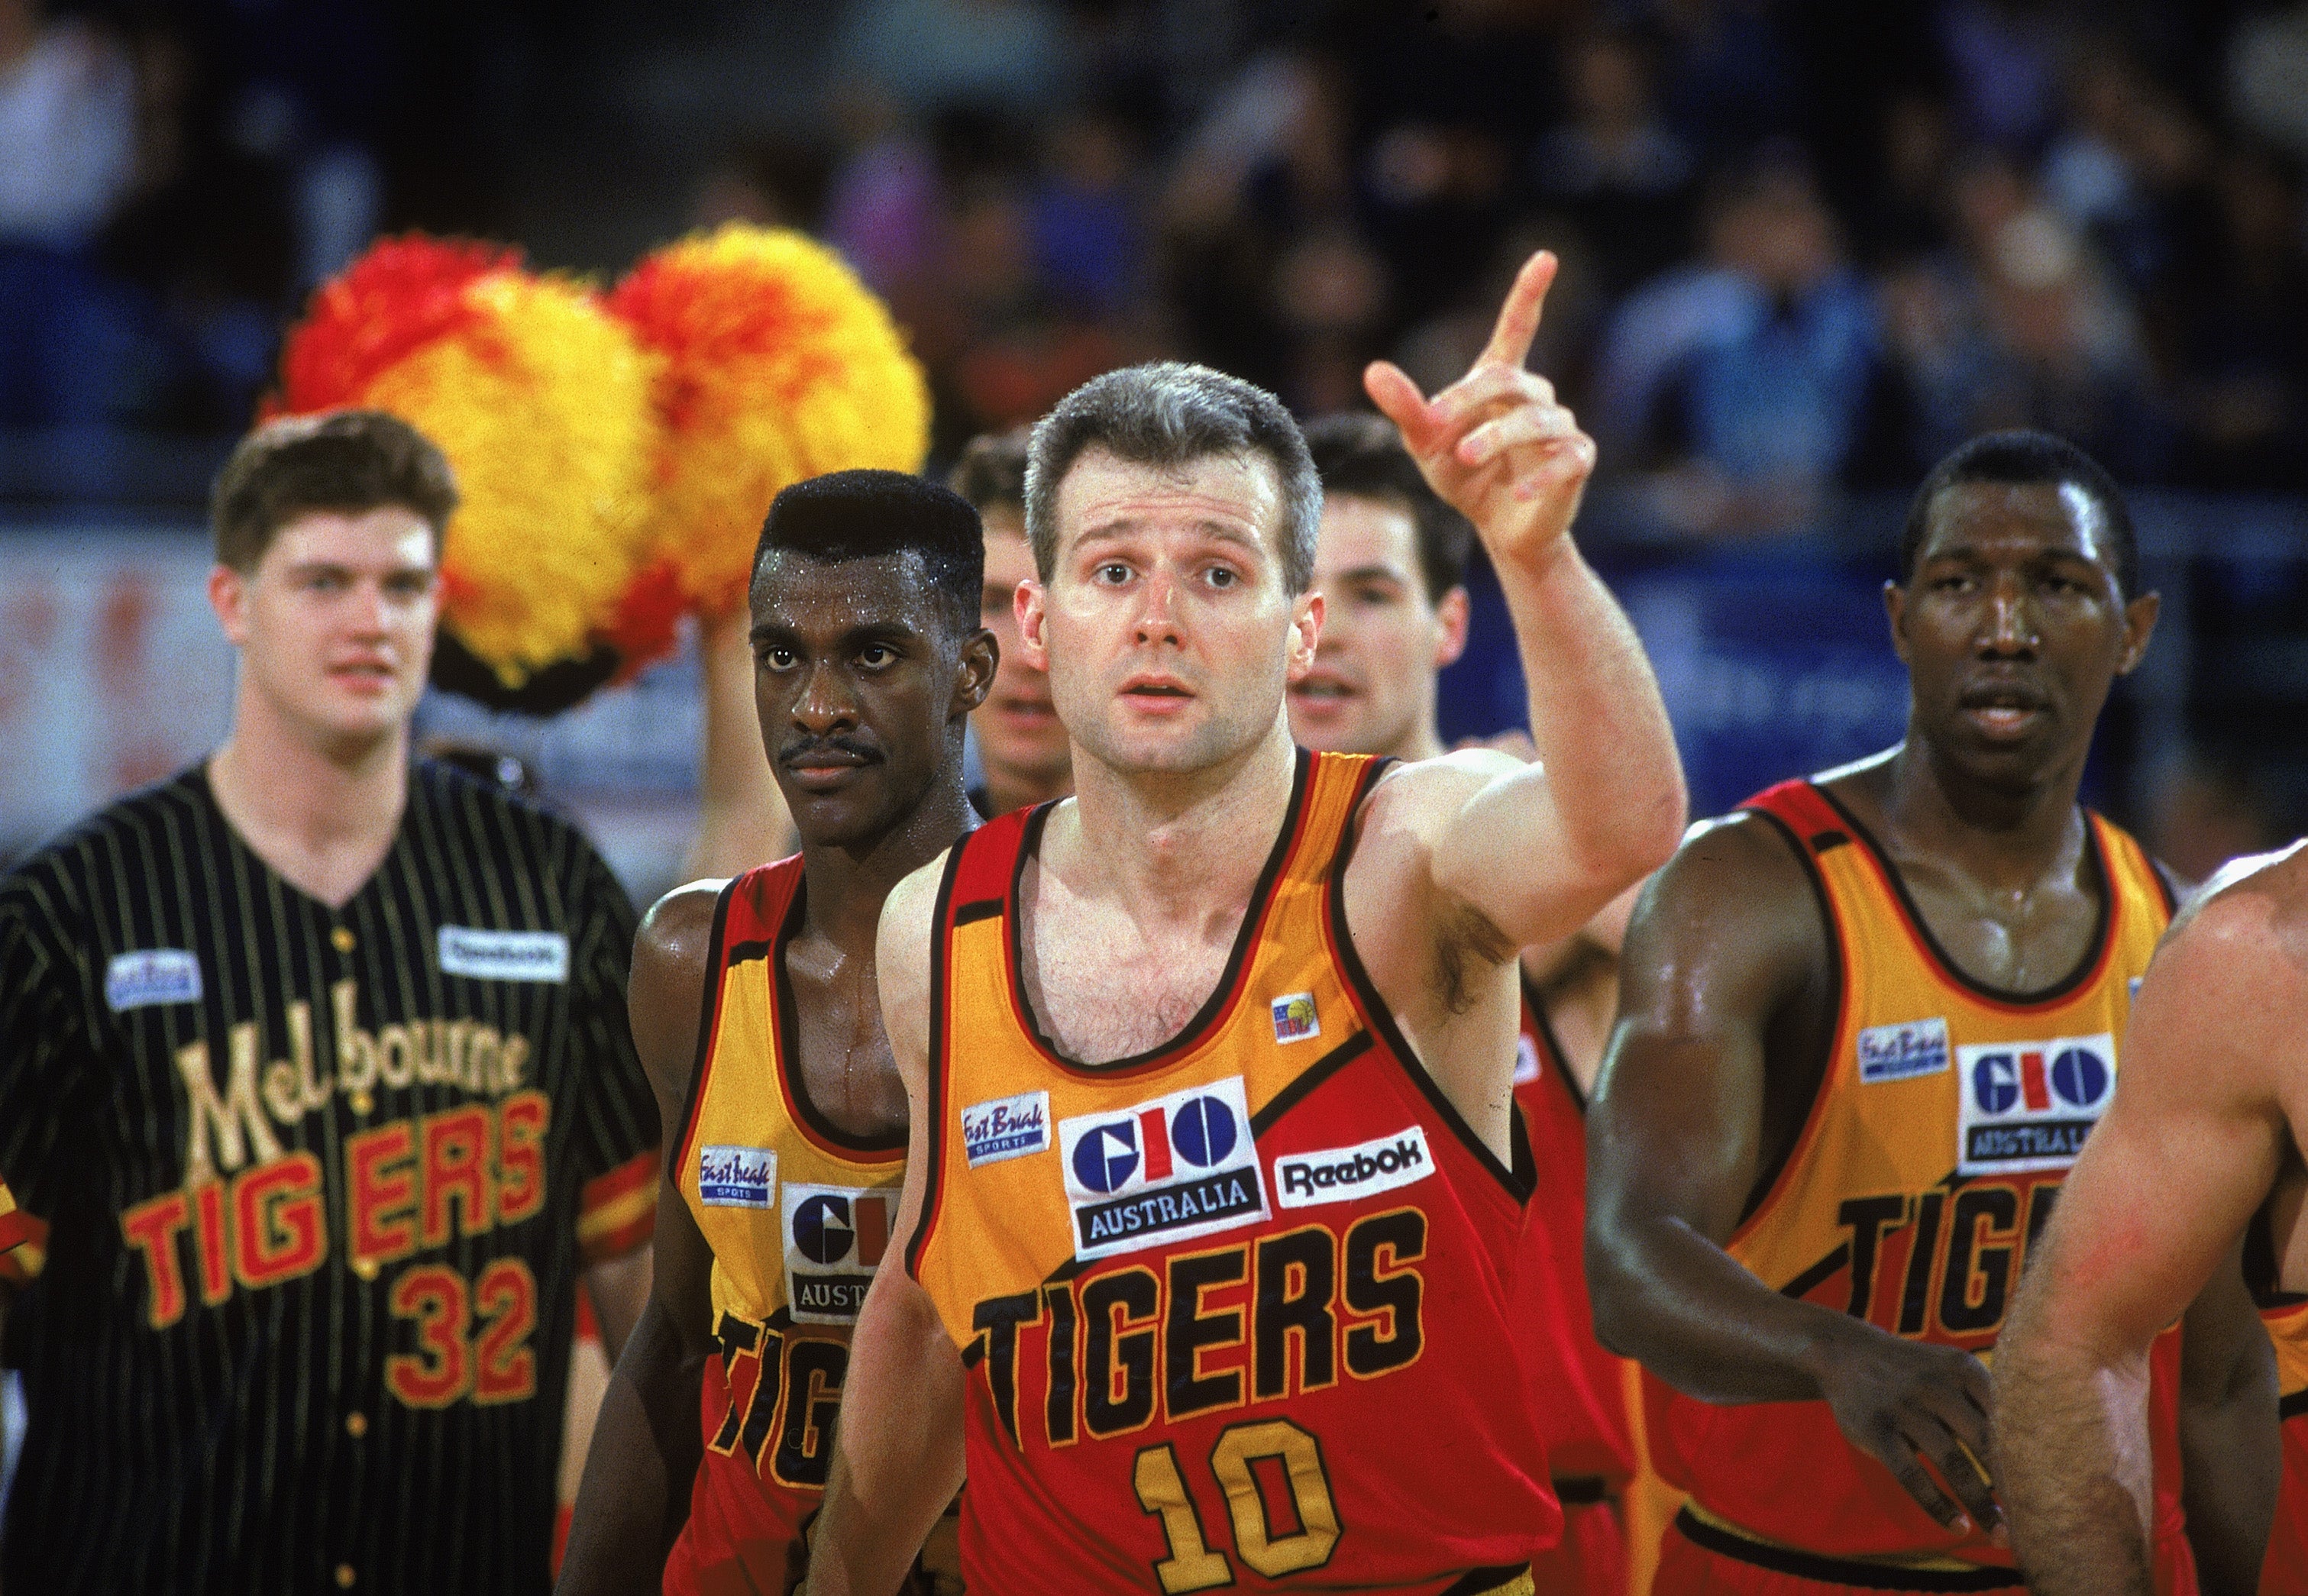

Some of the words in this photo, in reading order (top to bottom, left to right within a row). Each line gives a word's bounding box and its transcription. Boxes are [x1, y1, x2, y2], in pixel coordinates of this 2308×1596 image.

[176, 981, 531, 1188] Melbourne
[1072, 1095, 1238, 1193] GIO
[1973, 1126, 2091, 1157] AUSTRAL
[121, 1090, 550, 1329] TIGERS
[793, 1194, 897, 1267] GI
[1090, 1179, 1249, 1239] AUSTRALIA
[1283, 1140, 1424, 1197] Reebok
[386, 1257, 538, 1408] 32
[972, 1206, 1428, 1452] TIGERS
[1837, 1183, 2064, 1338] TIG
[707, 1308, 849, 1491] TIG
[1132, 1417, 1344, 1595] 10
